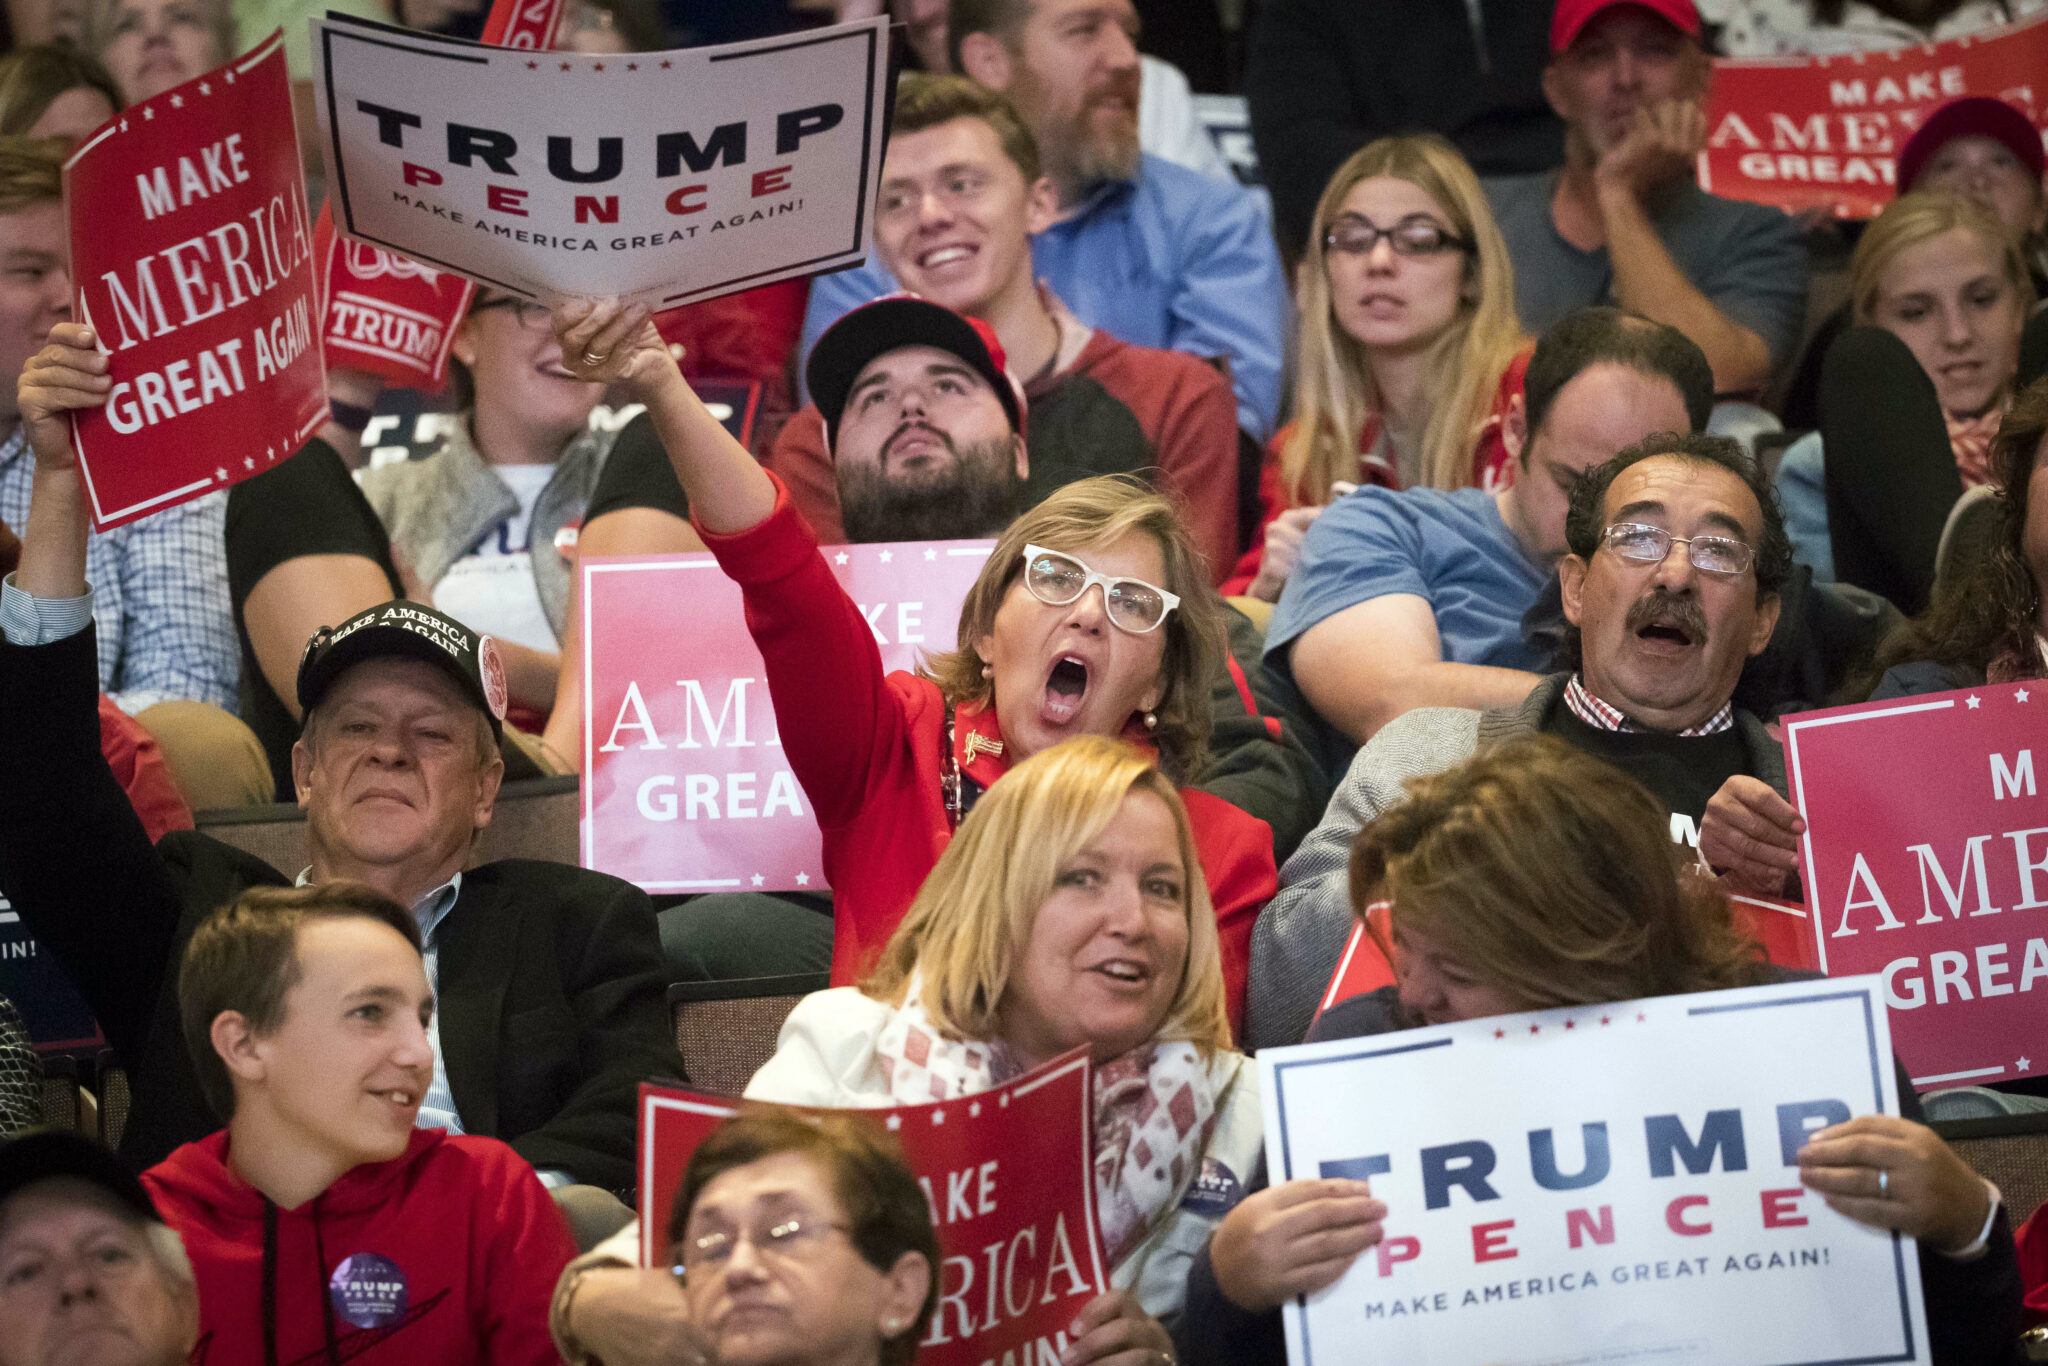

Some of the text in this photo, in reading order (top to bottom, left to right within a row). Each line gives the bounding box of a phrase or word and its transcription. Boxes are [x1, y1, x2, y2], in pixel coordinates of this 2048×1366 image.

[1829, 66, 1965, 106] MAKE
[357, 100, 844, 184] TRUMP
[136, 134, 249, 219] MAKE
[403, 161, 793, 224] PENCE
[393, 191, 804, 251] MAKE AMERICA GREAT AGAIN!
[105, 294, 311, 434] GREAT AGAIN
[330, 607, 470, 652] MAKE AMERICA
[402, 621, 460, 657] AGAIN
[857, 602, 925, 645] KE
[636, 769, 804, 821] GREA
[2, 940, 36, 960] IN!
[1881, 937, 2048, 1010] GREA
[1376, 1188, 1809, 1278] PENCE
[919, 1210, 1092, 1347] RICA
[1365, 1247, 1830, 1320] MAKE AMERICA GREAT AGAIN!
